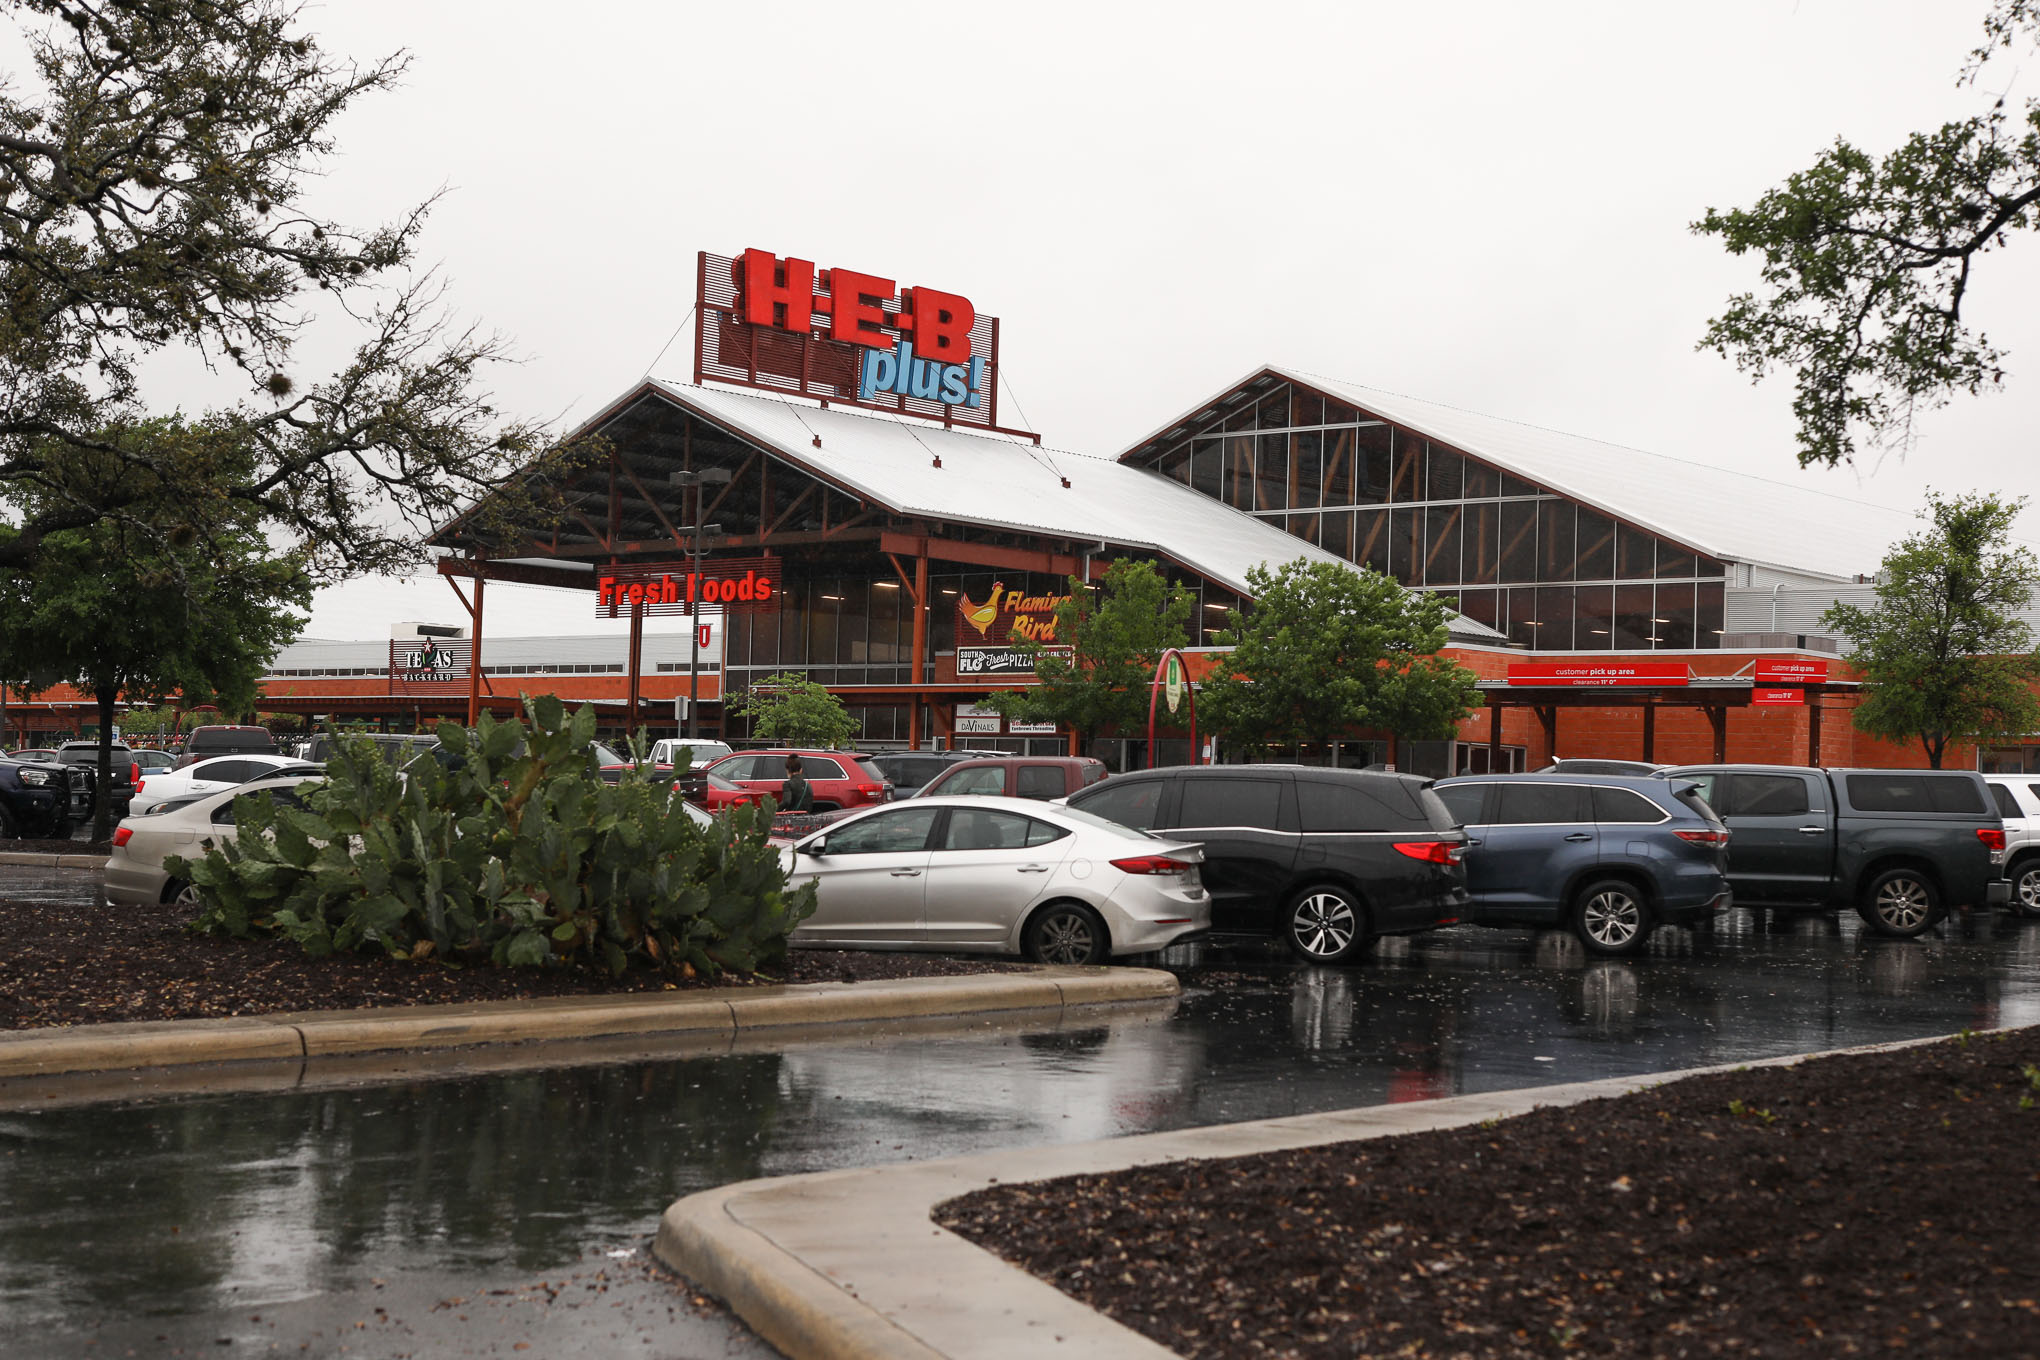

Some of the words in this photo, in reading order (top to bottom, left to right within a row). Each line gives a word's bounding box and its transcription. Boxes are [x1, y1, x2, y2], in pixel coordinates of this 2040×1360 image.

[744, 247, 975, 365] H-E-B
[860, 341, 985, 408] plus!
[599, 575, 680, 606] Fresh
[1010, 614, 1059, 641] Bird
[960, 650, 979, 659] SOUTH
[986, 651, 1010, 667] Fresh
[1009, 653, 1034, 667] PIZZA
[960, 658, 983, 671] FLO
[1555, 668, 1589, 676] customer
[1589, 666, 1606, 677] pick
[1607, 668, 1617, 677] up
[1618, 668, 1635, 676] area
[403, 673, 452, 682] BACKYARD
